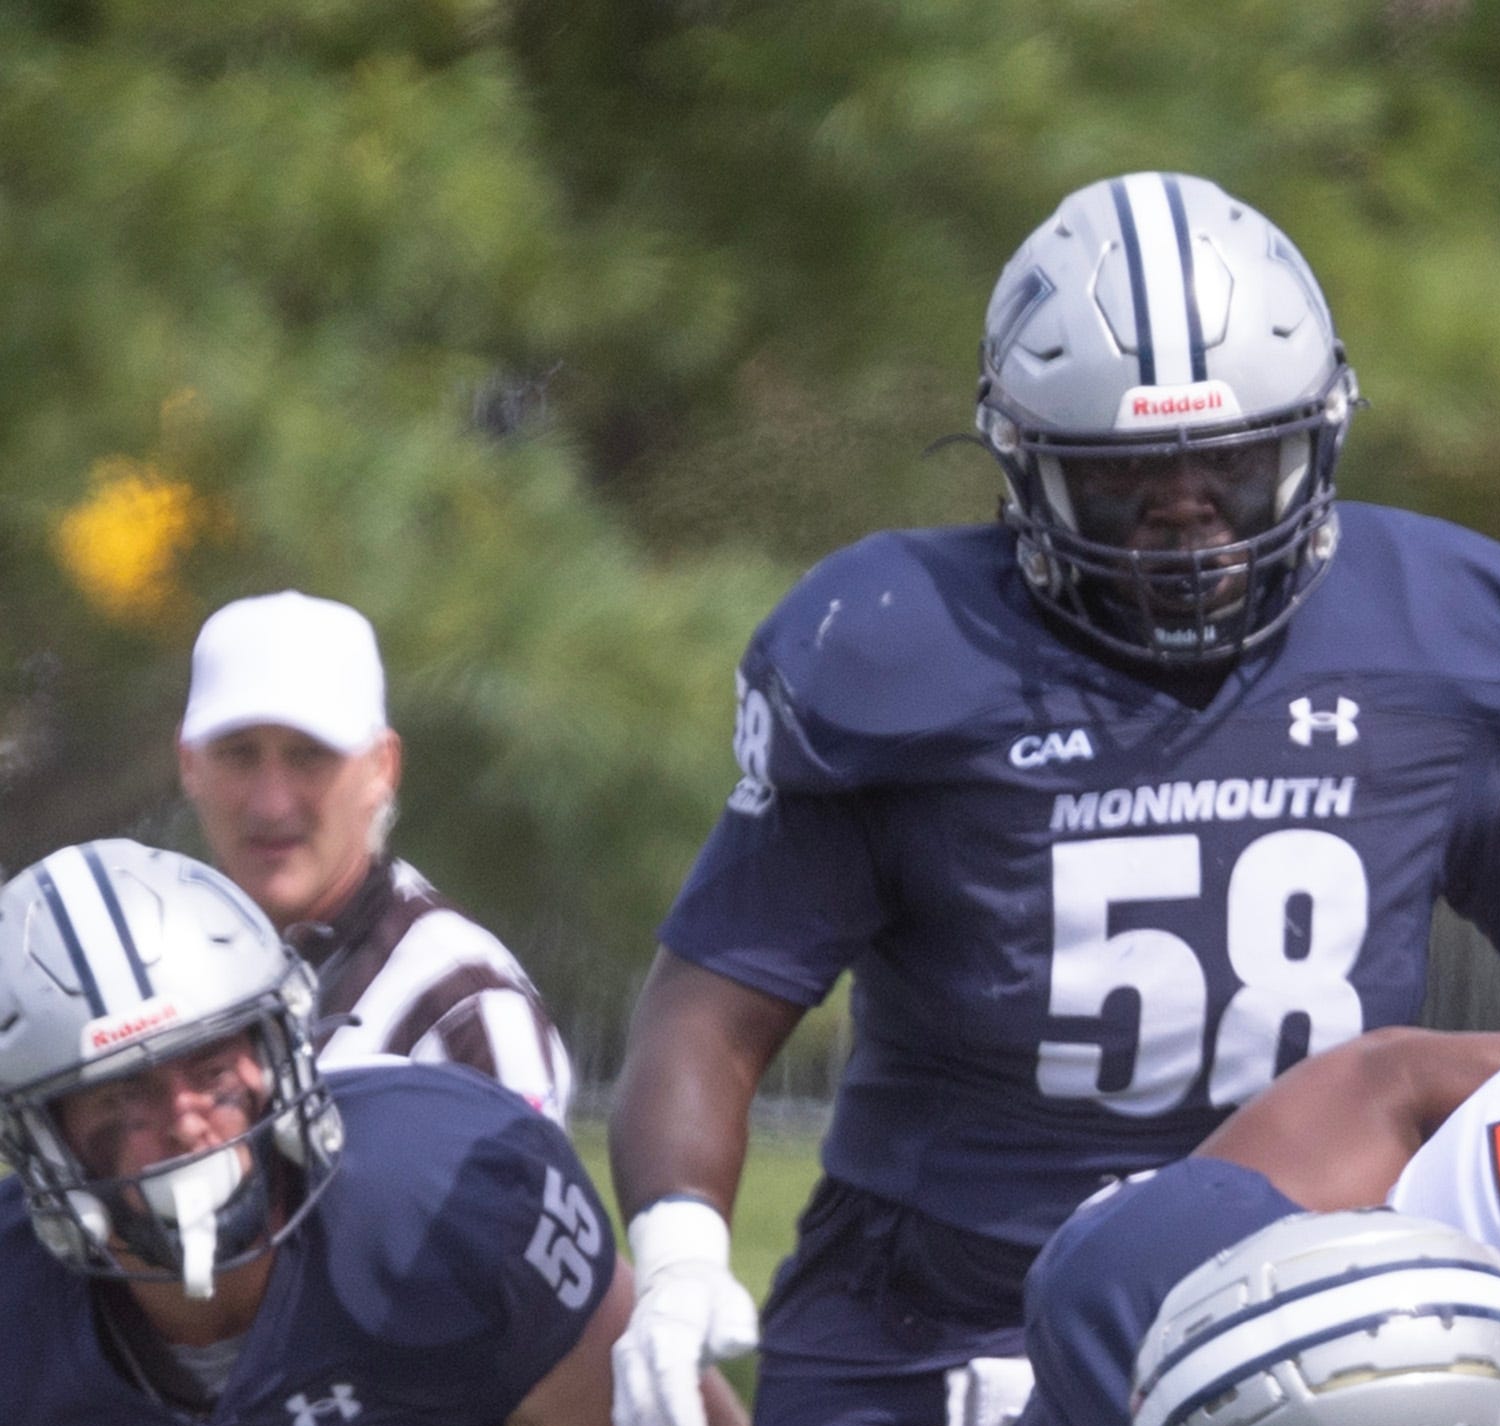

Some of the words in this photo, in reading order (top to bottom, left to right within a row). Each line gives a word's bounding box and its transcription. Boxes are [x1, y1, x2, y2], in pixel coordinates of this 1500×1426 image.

[1132, 390, 1223, 415] Riddell
[1009, 728, 1095, 768] CAA
[1049, 776, 1357, 832] MONMOUTH
[1036, 828, 1370, 1117] 58
[523, 1165, 602, 1311] 55
